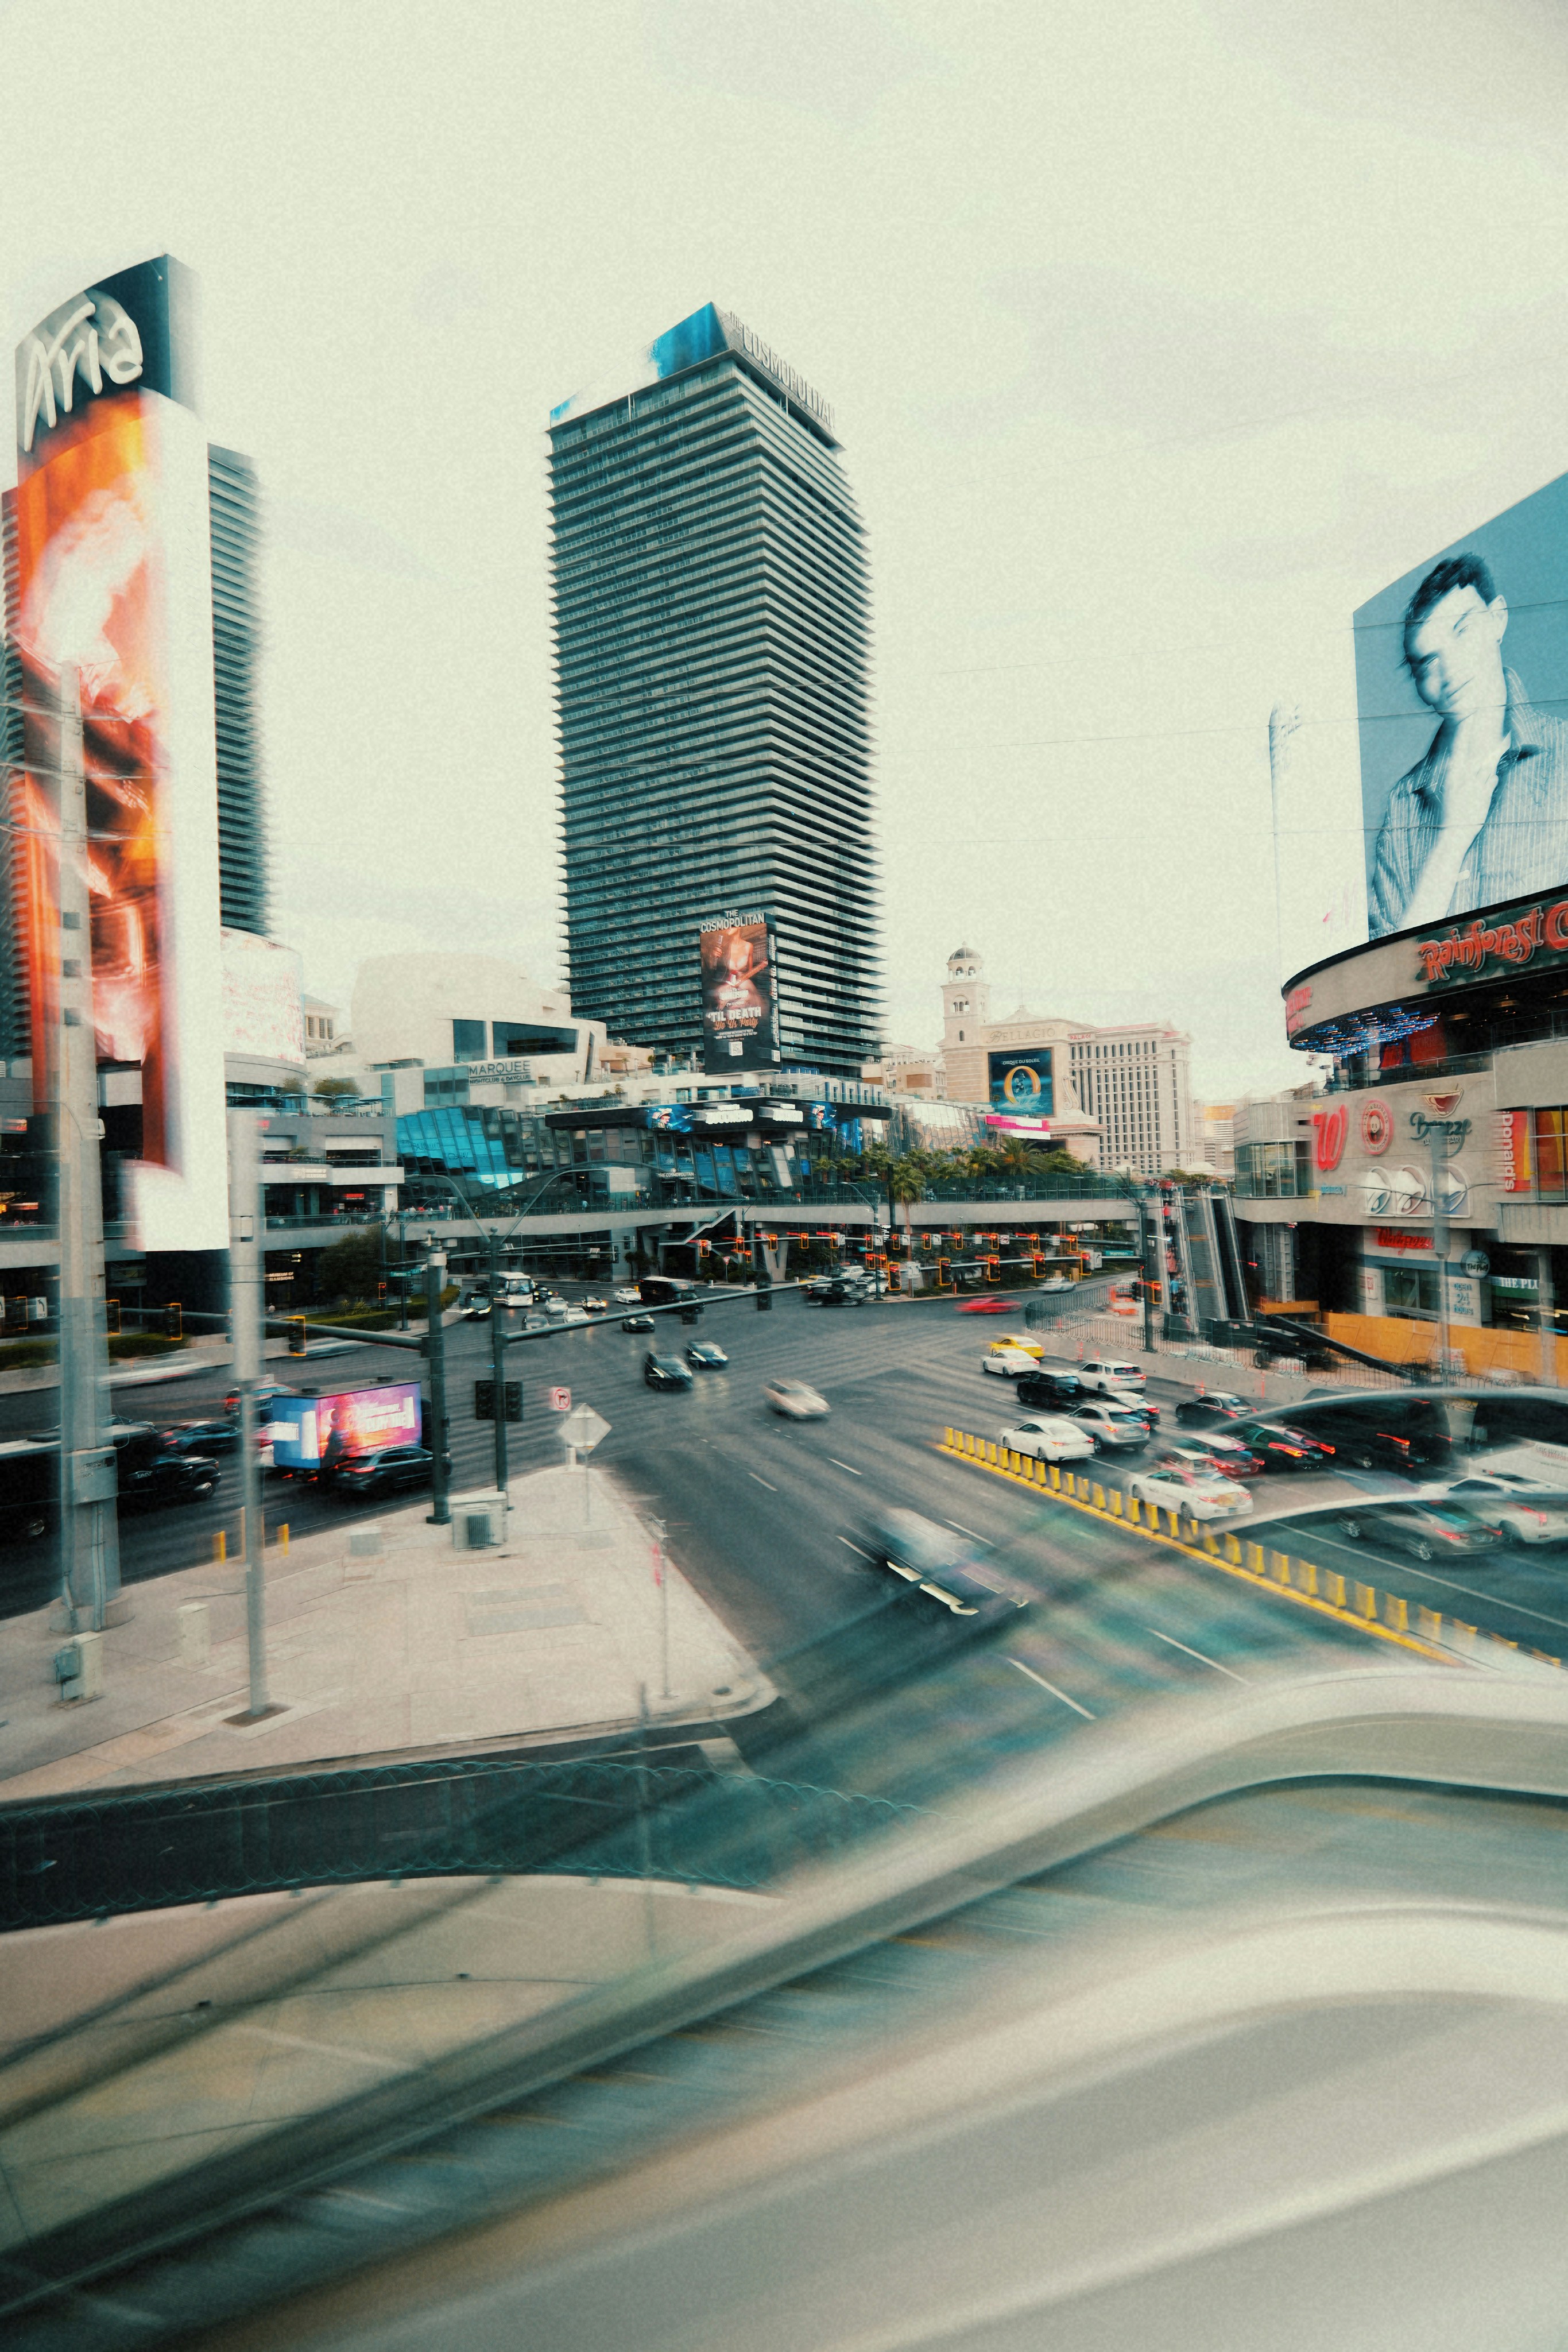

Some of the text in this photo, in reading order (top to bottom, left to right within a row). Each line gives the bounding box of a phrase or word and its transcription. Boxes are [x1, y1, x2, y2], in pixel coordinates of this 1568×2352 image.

[742, 324, 835, 428] COSMOPOLITAN
[726, 910, 738, 918] THE
[700, 913, 765, 933] COSMOPOLITAN
[1420, 906, 1544, 982] Rainforest
[728, 1007, 761, 1020] DEATH
[740, 1017, 758, 1028] Party
[470, 1061, 531, 1076] MARQUEE
[1502, 1111, 1516, 1190] Donald's
[1376, 1227, 1434, 1256] Walgreen
[1453, 1283, 1472, 1291] open
[1501, 1277, 1540, 1290] THE PLU
[1457, 1292, 1470, 1305] 24
[1454, 1305, 1474, 1315] hours
